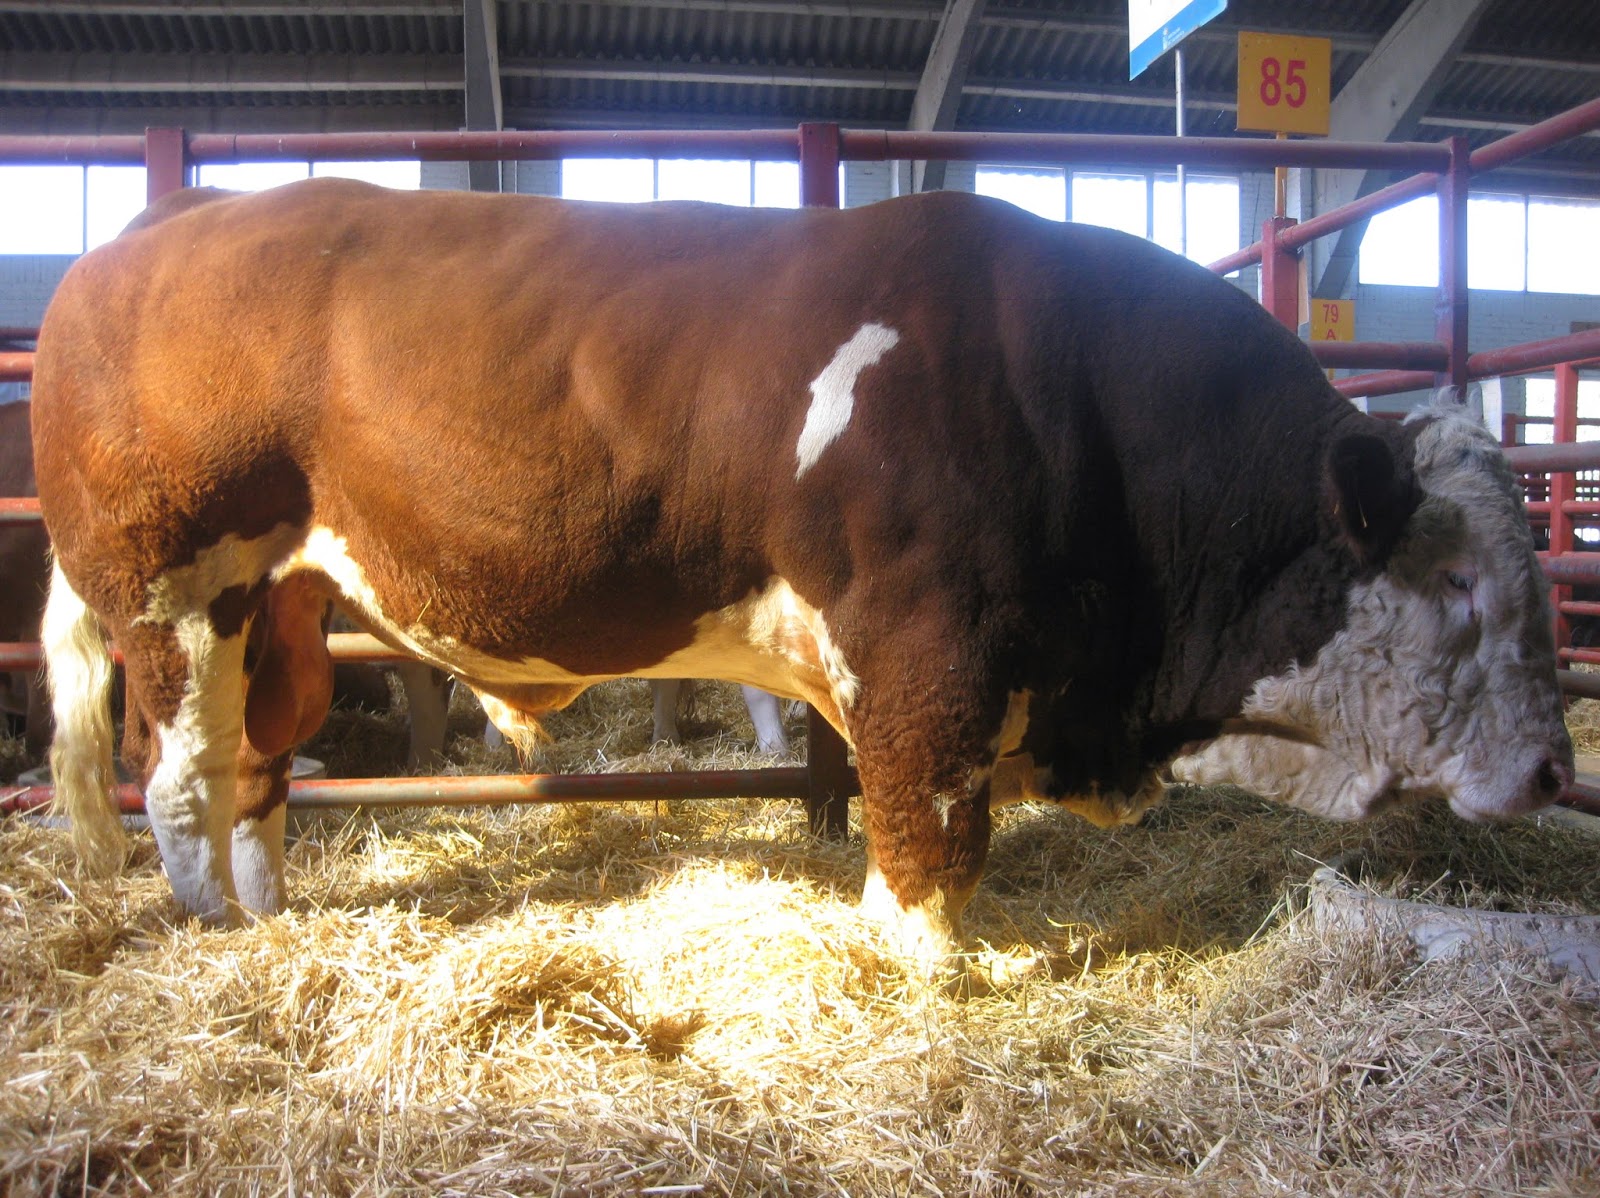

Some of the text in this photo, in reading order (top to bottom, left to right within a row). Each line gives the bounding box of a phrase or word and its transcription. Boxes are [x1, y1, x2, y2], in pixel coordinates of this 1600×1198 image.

[1260, 57, 1307, 108] 85
[1322, 303, 1339, 323] 79
[1326, 328, 1337, 341] A
